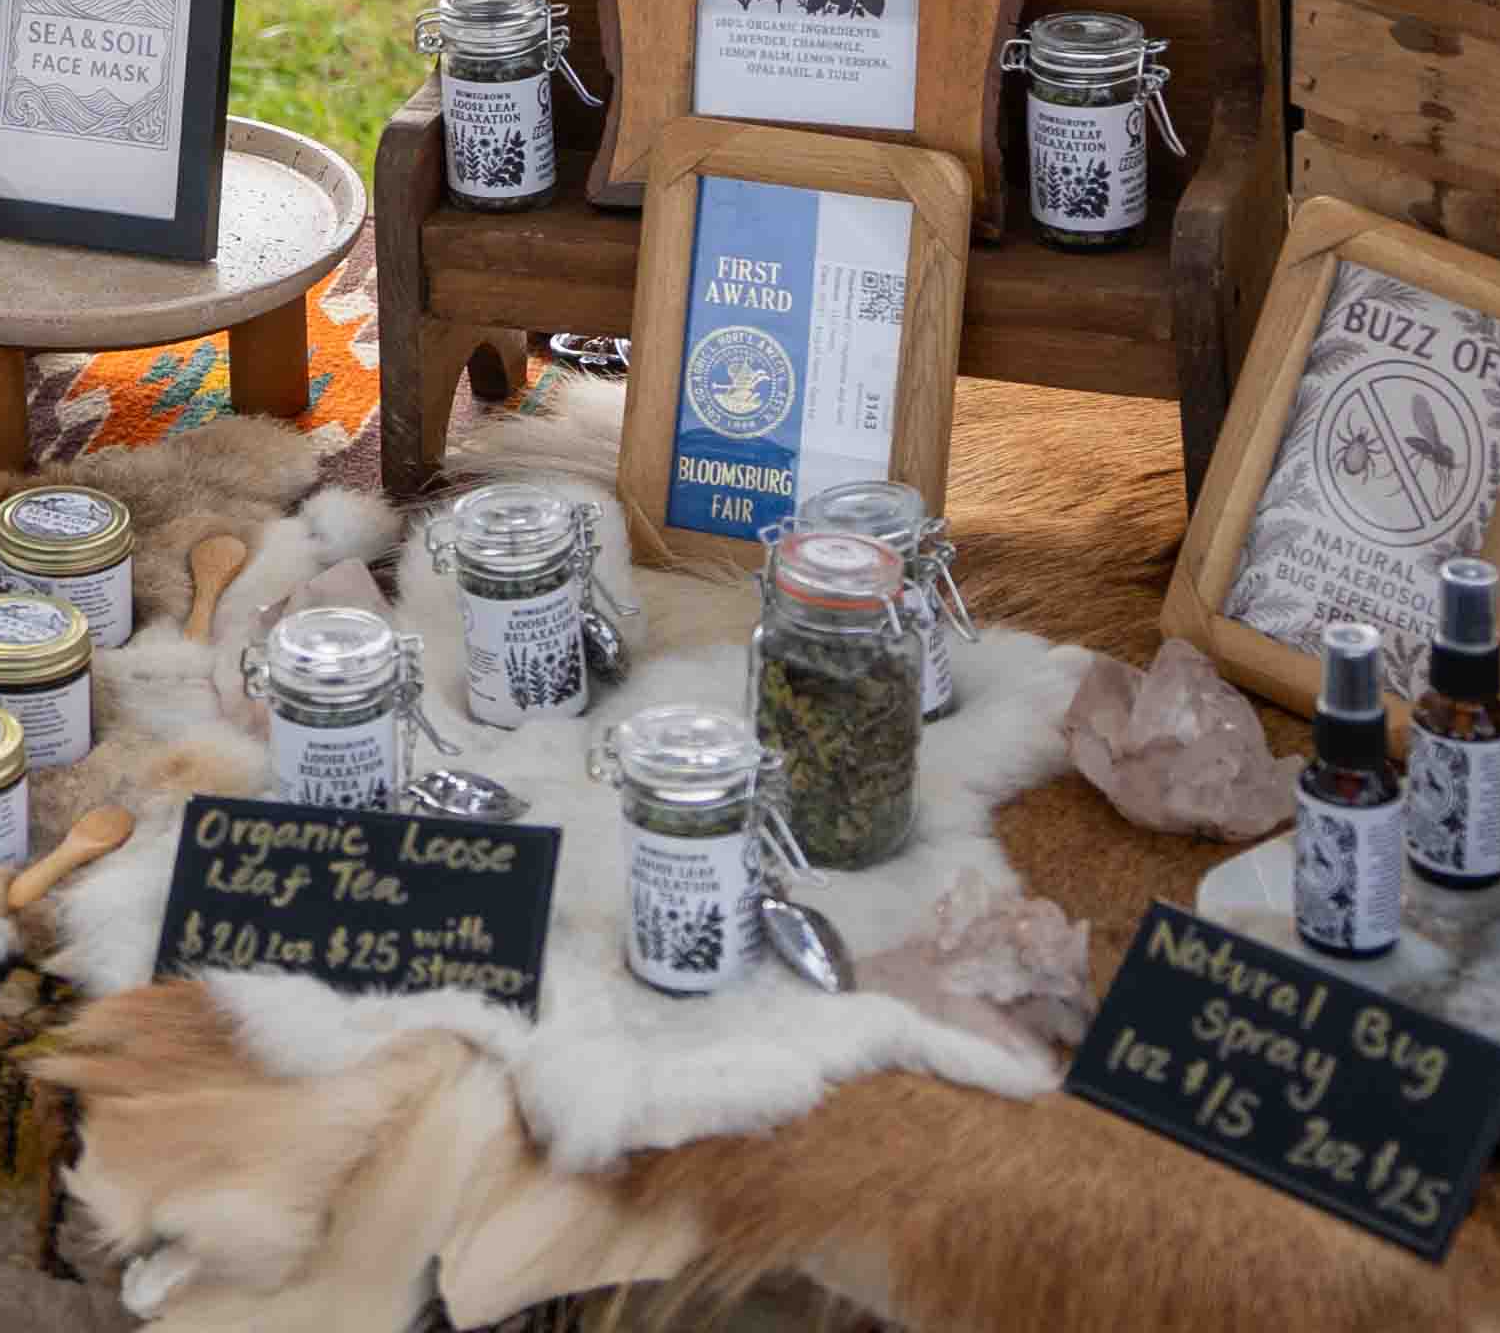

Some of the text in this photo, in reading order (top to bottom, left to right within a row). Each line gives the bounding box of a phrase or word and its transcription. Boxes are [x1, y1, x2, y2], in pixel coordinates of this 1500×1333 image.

[28, 20, 159, 59] SEA & SOIL
[31, 52, 150, 86] FACE MASK
[472, 124, 497, 136] TEA
[705, 280, 793, 313] AWARD
[717, 256, 782, 284] FIRST
[1344, 301, 1441, 361] BUZZ
[678, 456, 793, 495] BLOOMSBURG
[711, 493, 753, 523] FAIR
[1285, 545, 1438, 617] NON-AEROSOL
[1312, 530, 1417, 585] NATURAL
[1275, 563, 1437, 637] BUG REPELLENT
[195, 808, 518, 873] Organic Loose
[204, 858, 409, 907] Leaf Tea
[326, 927, 400, 971] $25
[412, 914, 492, 952] with
[1148, 917, 1449, 1101] Natural Bug
[1191, 997, 1338, 1113] Spray
[1181, 1059, 1262, 1137] $15
[1286, 1117, 1366, 1183] 2oz
[1366, 1140, 1453, 1227] $25
